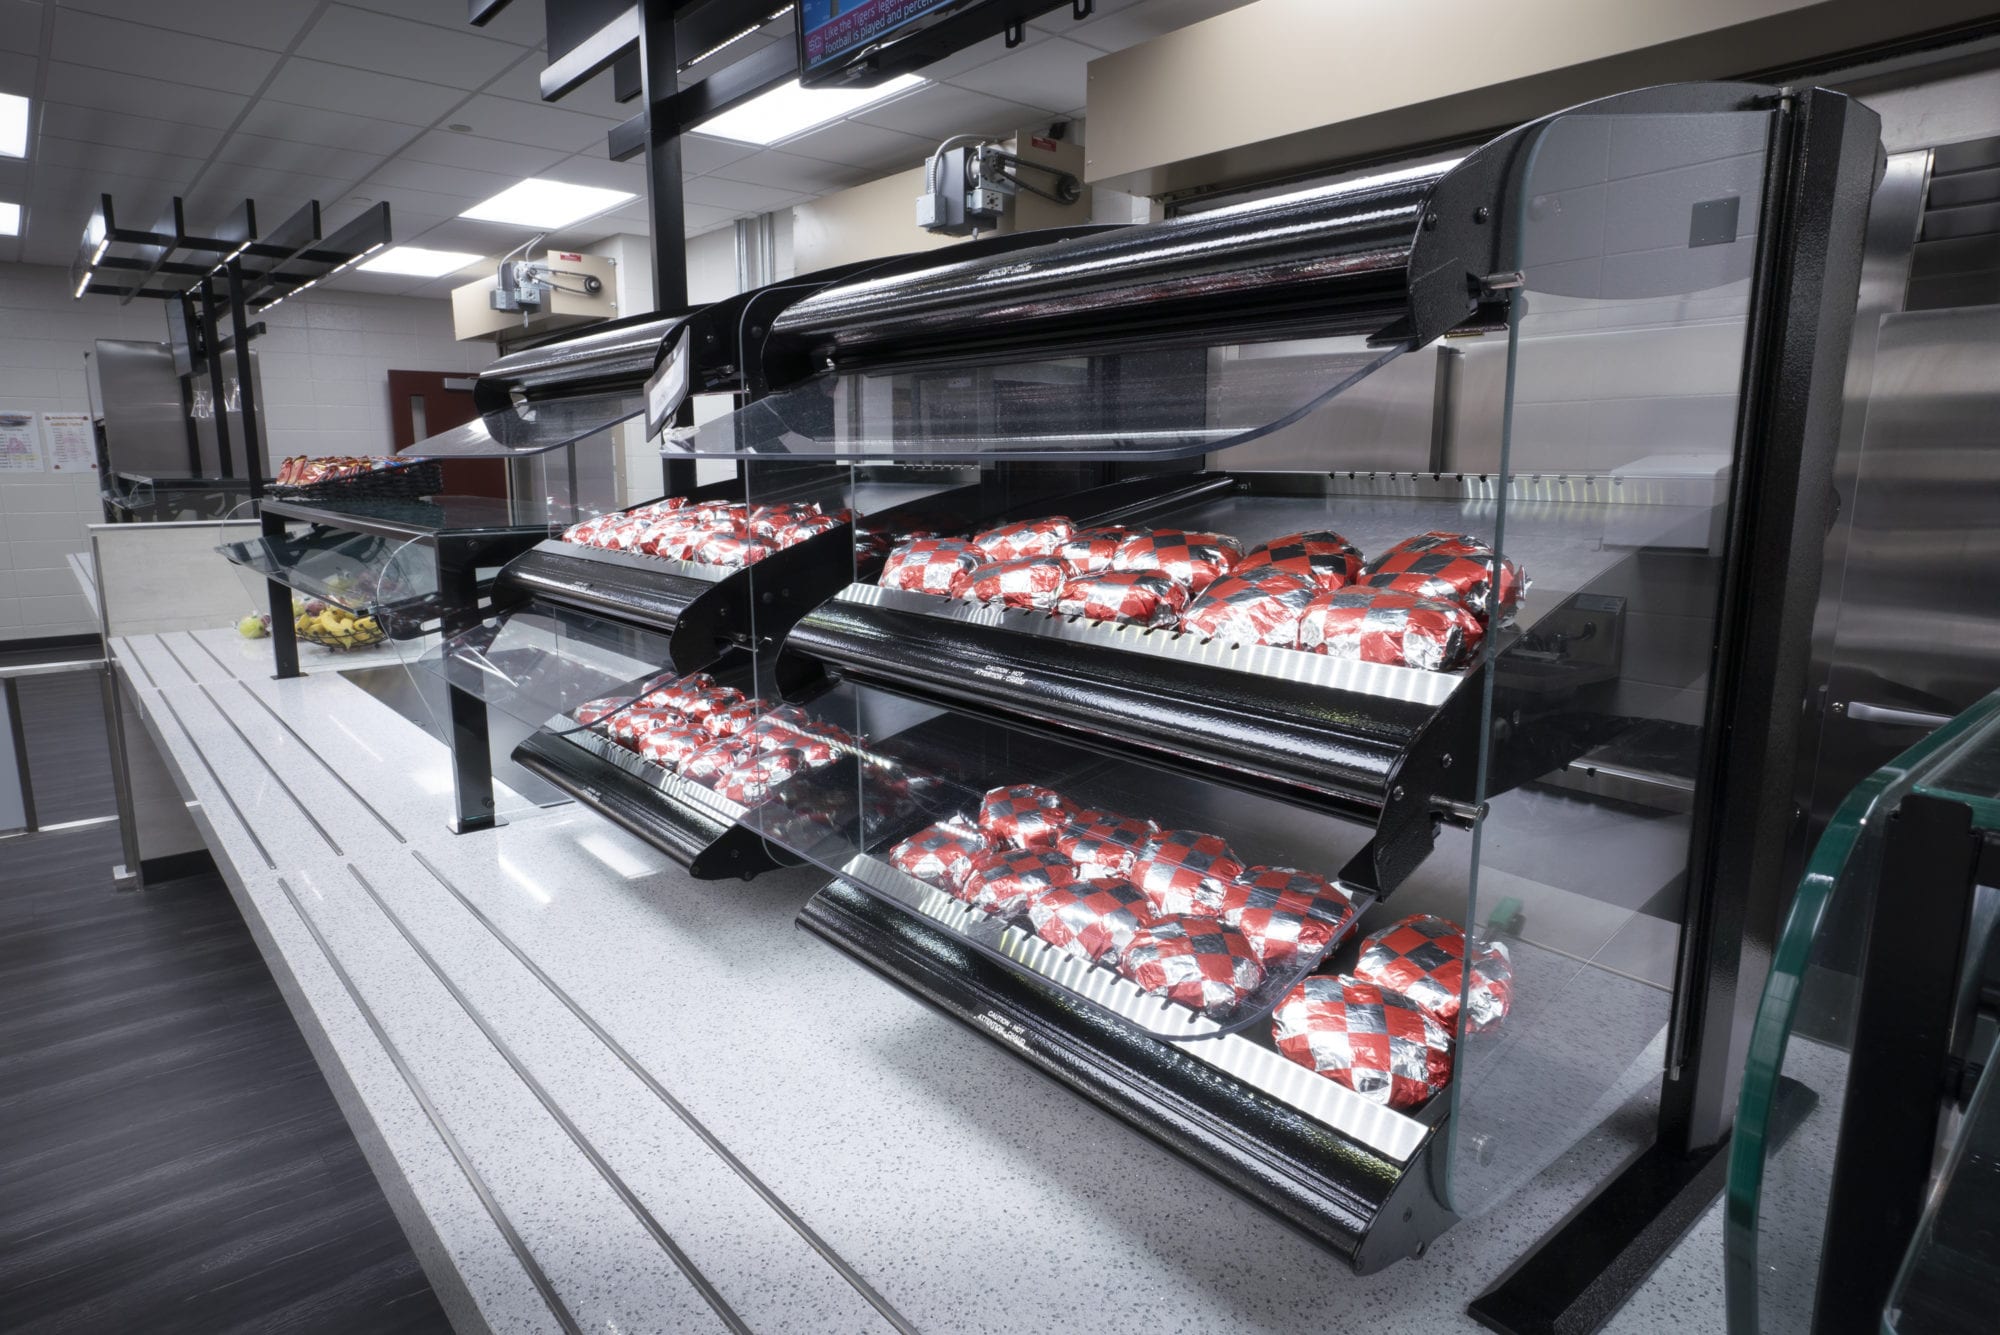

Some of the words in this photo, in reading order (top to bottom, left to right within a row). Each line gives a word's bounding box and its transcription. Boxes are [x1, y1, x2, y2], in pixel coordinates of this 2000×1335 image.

[824, 26, 839, 40] Like
[839, 18, 851, 33] the
[825, 31, 852, 54] football
[853, 30, 860, 40] is
[860, 15, 885, 39] played
[886, 5, 903, 24] and
[985, 664, 1009, 674] CAUTION
